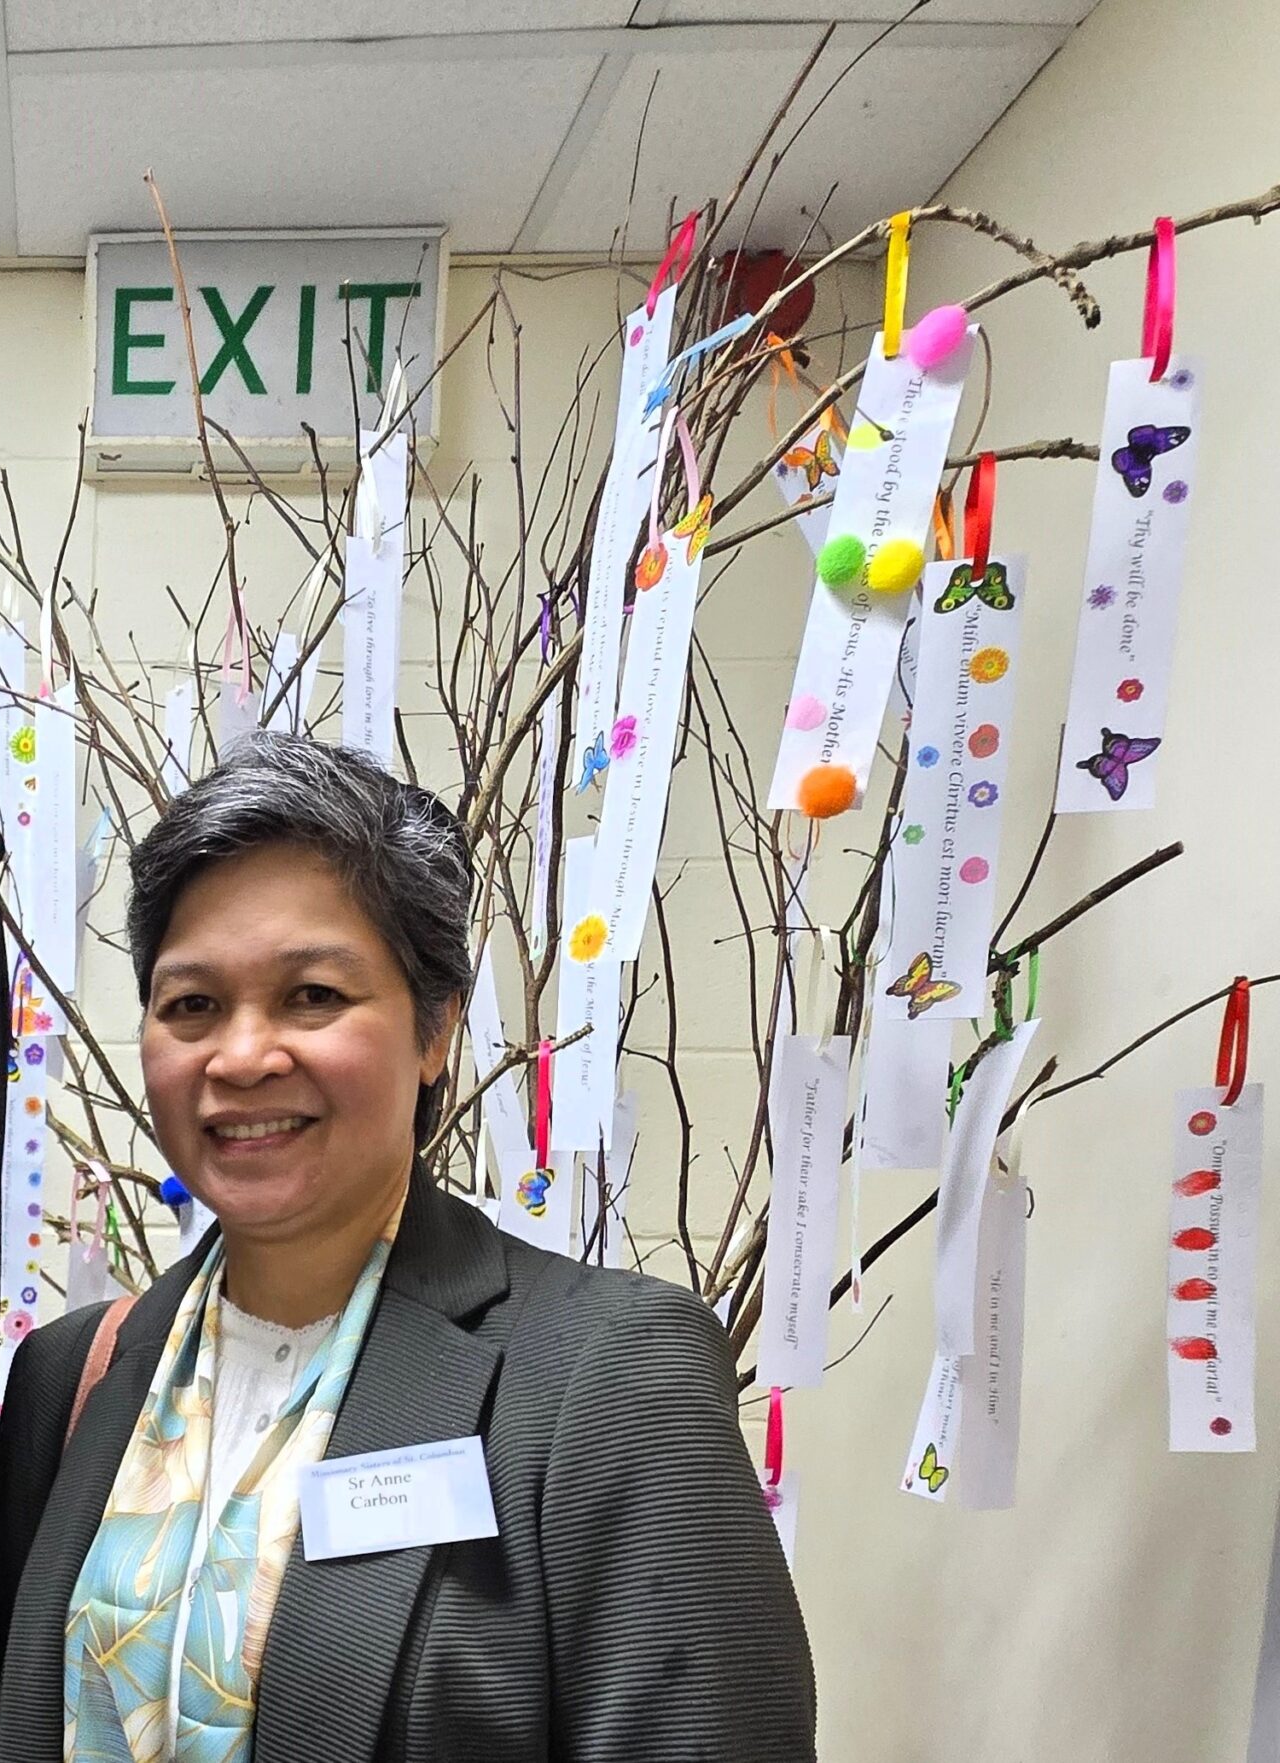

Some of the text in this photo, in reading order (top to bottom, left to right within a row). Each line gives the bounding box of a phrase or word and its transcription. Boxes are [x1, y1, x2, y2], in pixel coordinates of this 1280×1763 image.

[112, 283, 421, 395] EXIT
[886, 430, 908, 478] stood
[875, 482, 899, 502] by
[871, 510, 891, 537] the
[1126, 553, 1146, 588] will
[851, 593, 872, 612] of
[1125, 590, 1143, 608] be
[365, 612, 376, 633] live
[841, 612, 868, 662] Jesus,
[362, 637, 376, 682] through
[835, 666, 854, 699] His
[364, 686, 375, 709] love
[363, 712, 373, 724] in
[950, 712, 968, 767] vivere
[633, 774, 643, 790] in
[626, 795, 642, 834] Jesus
[941, 839, 956, 861] est
[614, 838, 635, 898] through
[937, 866, 953, 905] mori
[585, 976, 597, 994] the
[581, 1043, 593, 1055] of
[800, 1131, 814, 1150] for
[799, 1155, 813, 1187] their
[1211, 1140, 1227, 1189] "Omn
[796, 1190, 810, 1218] sake
[790, 1231, 804, 1298] consecrate
[1207, 1249, 1222, 1261] in
[990, 1297, 1000, 1309] in
[990, 1313, 1001, 1331] me
[1205, 1310, 1218, 1329] me
[989, 1371, 1000, 1383] in
[348, 1473, 413, 1490] Sr Anne
[350, 1492, 409, 1510] Carbon
